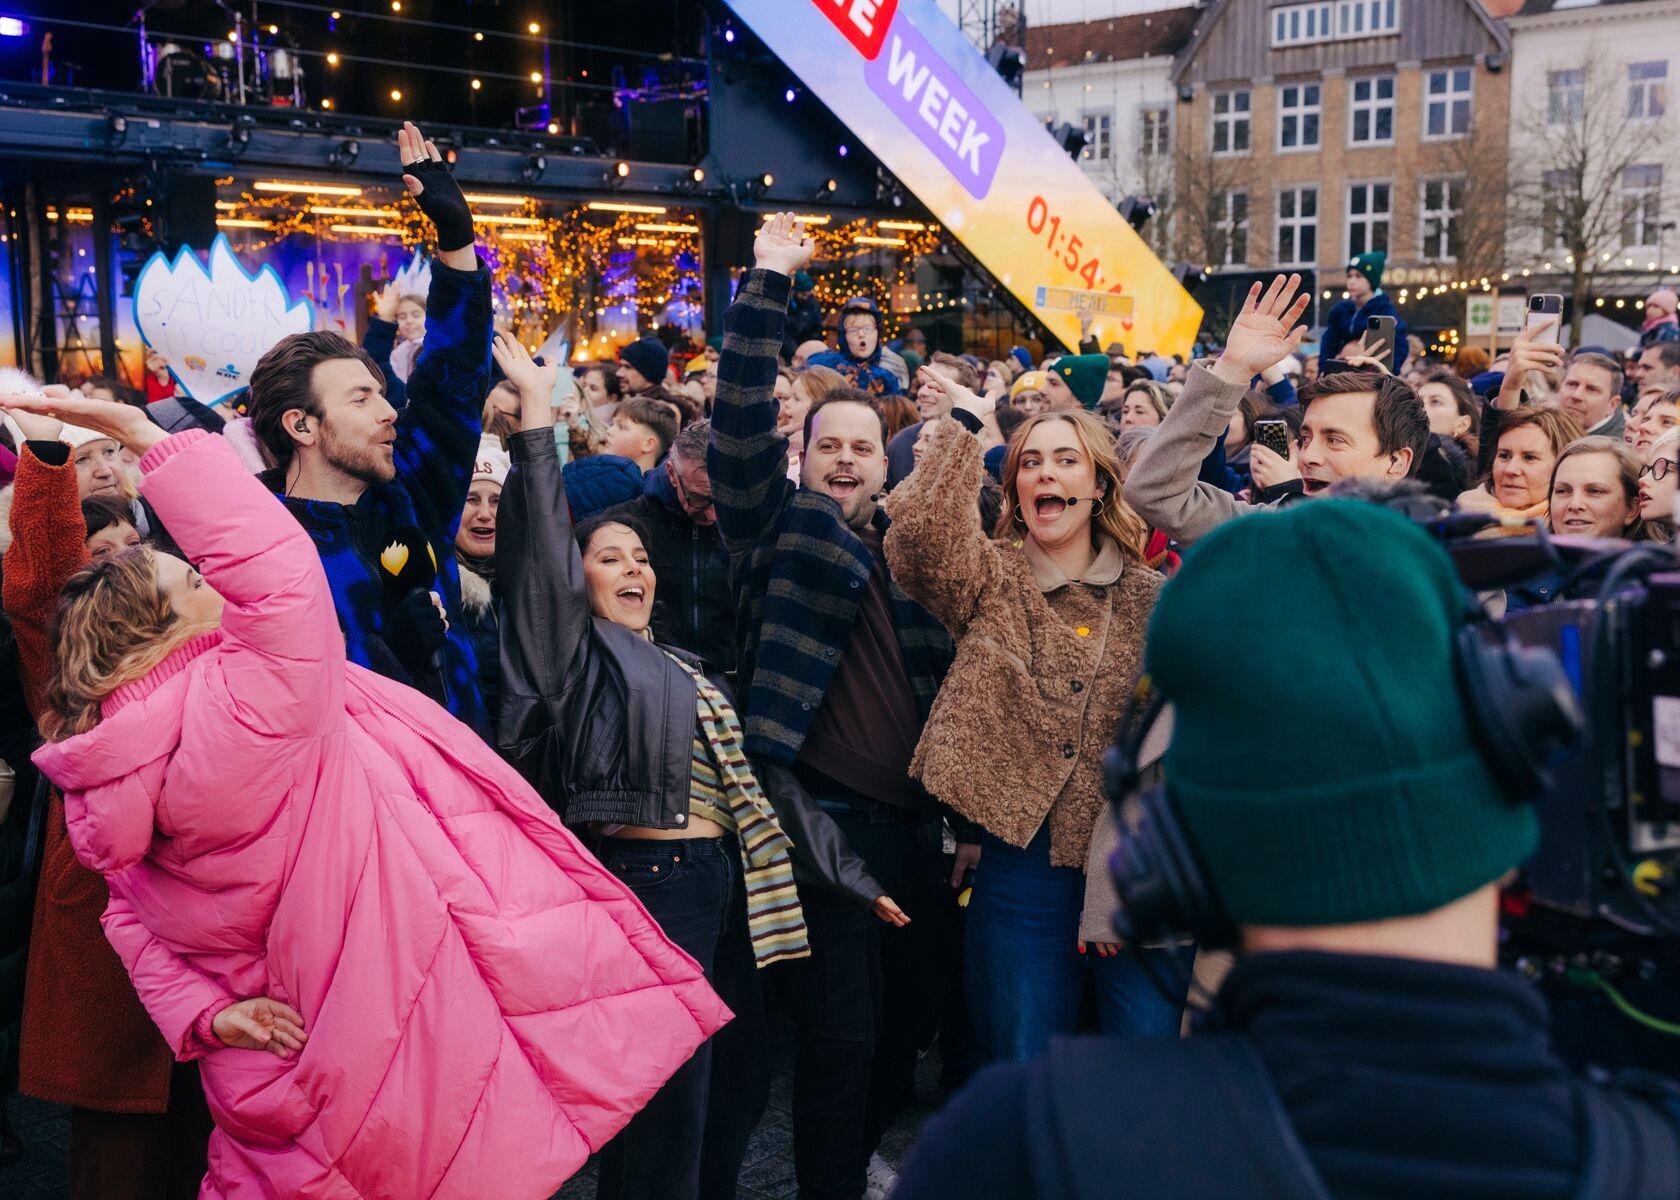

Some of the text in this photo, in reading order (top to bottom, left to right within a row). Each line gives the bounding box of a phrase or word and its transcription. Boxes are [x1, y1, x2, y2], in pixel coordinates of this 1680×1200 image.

[887, 34, 990, 177] WEEK
[144, 277, 281, 326] SANDER
[473, 461, 493, 474] LS
